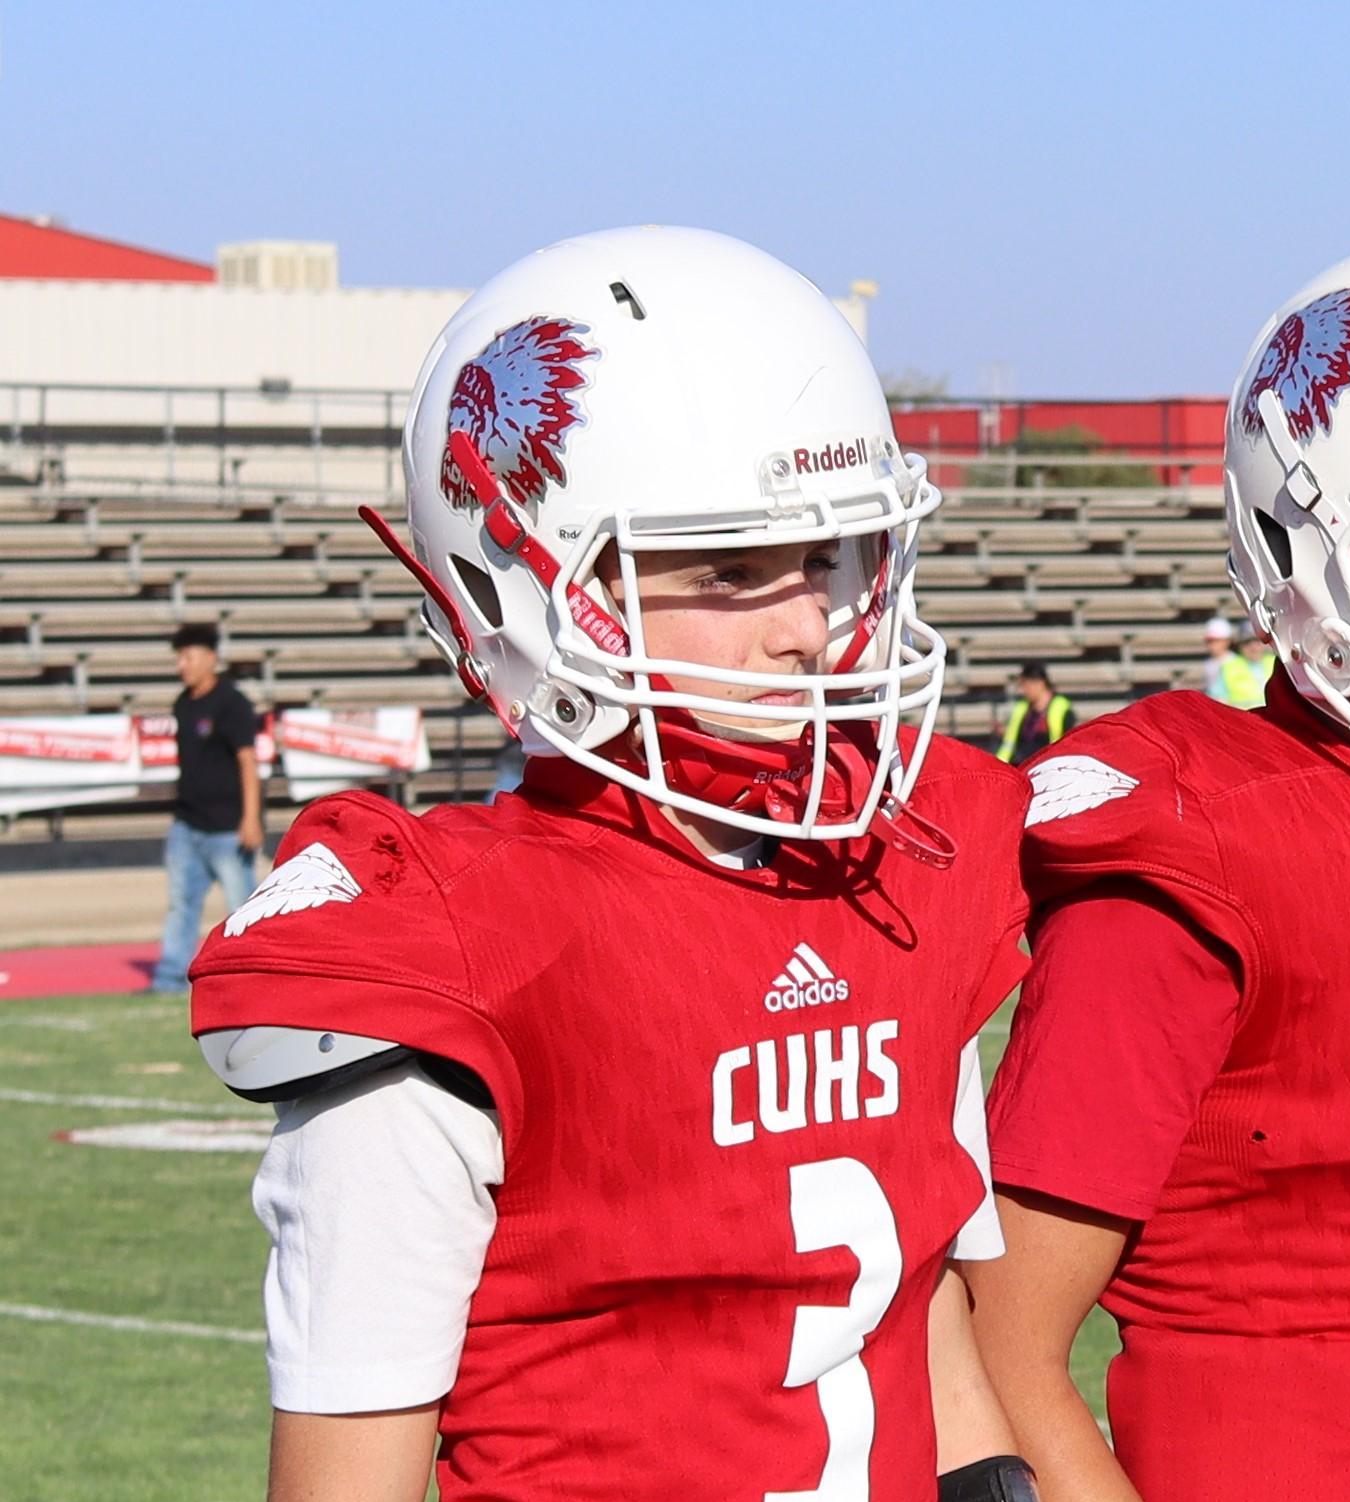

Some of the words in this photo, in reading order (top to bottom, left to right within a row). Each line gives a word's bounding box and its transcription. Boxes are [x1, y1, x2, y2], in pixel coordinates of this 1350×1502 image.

[793, 437, 868, 474] Riddell
[764, 979, 850, 1013] adidas
[712, 1019, 899, 1147] CUHS
